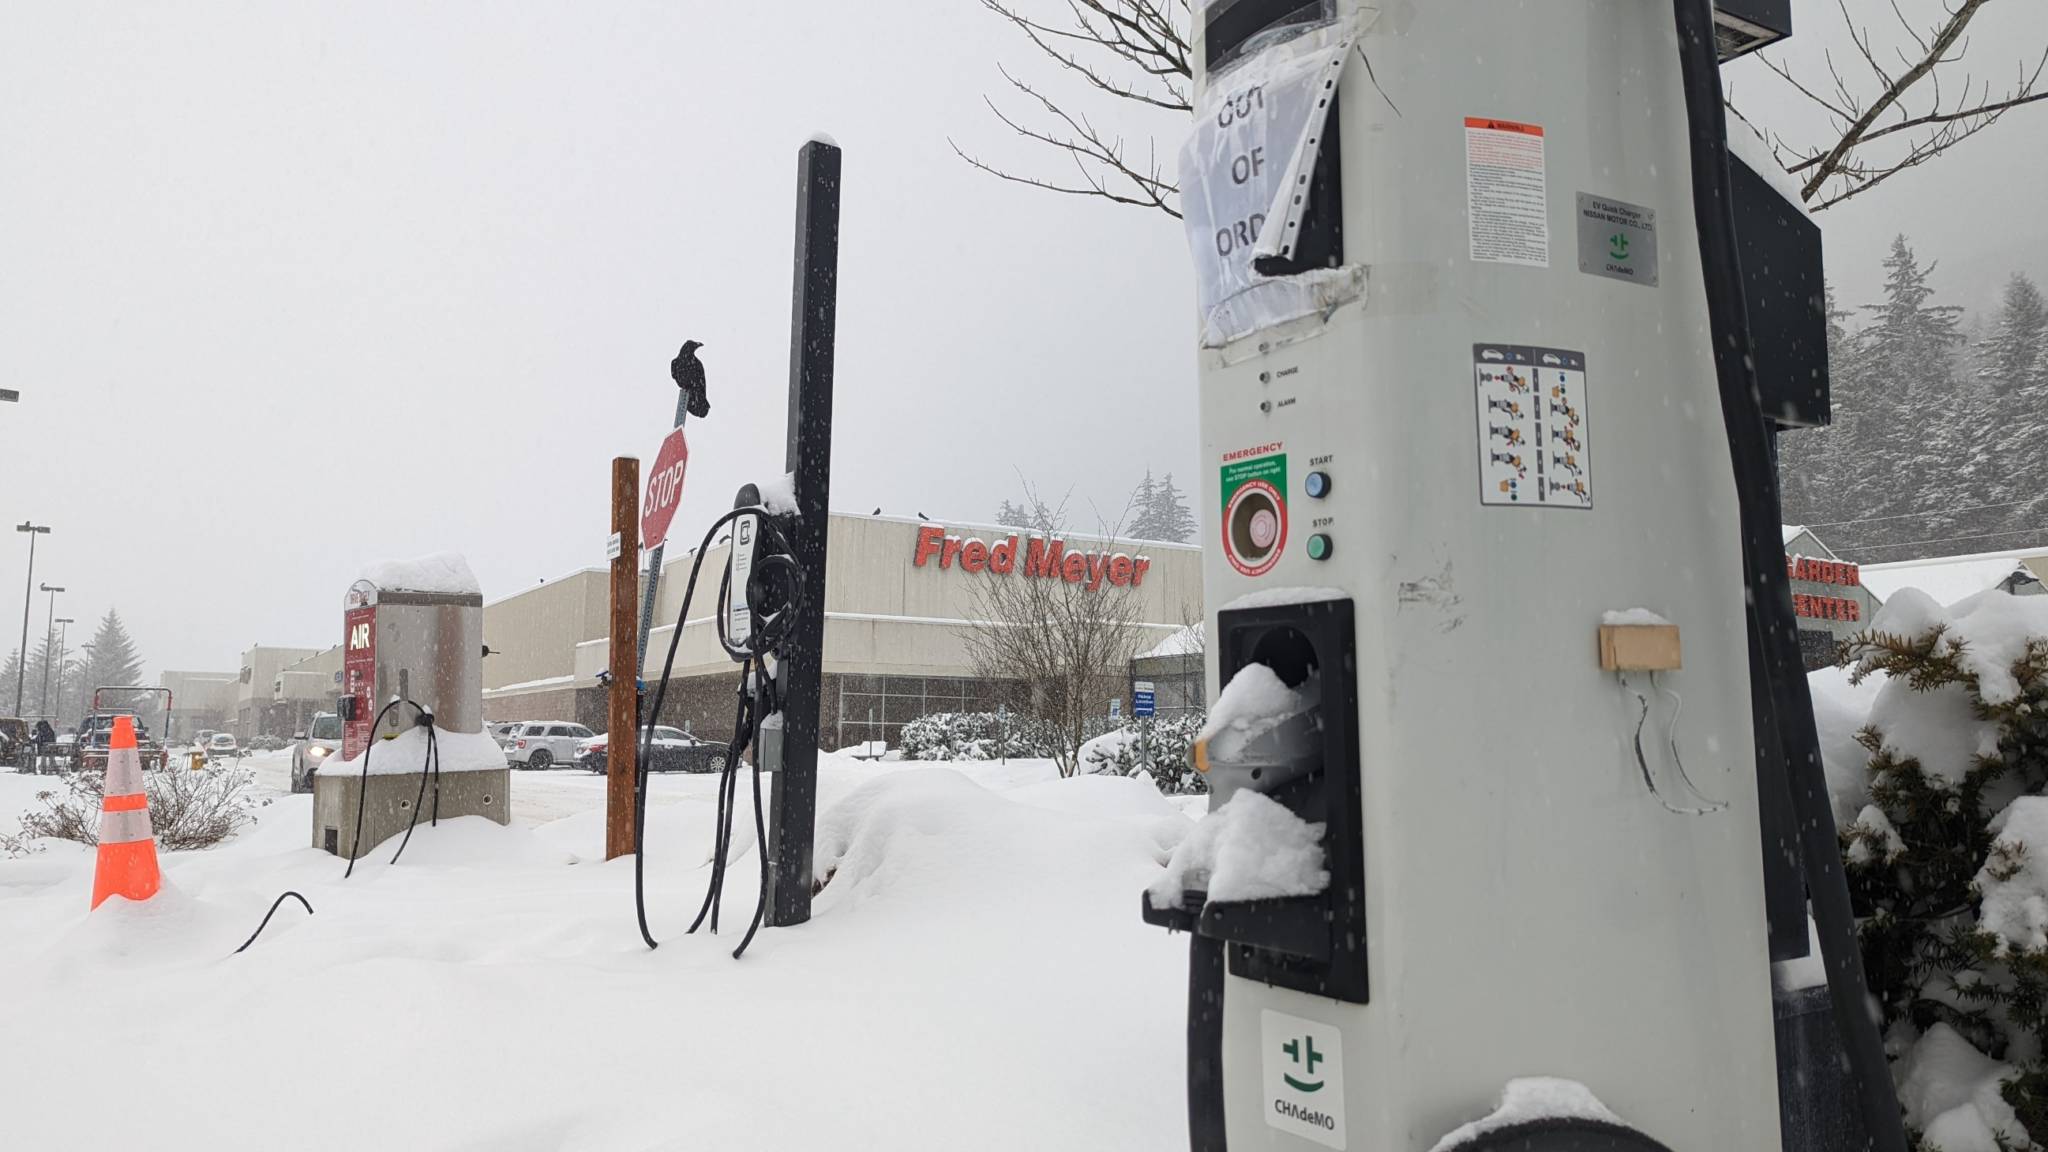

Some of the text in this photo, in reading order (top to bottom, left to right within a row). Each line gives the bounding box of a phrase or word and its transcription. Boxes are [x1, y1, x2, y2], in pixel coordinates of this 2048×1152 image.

[1218, 84, 1267, 128] OUT
[1232, 147, 1265, 184] OF
[1583, 210, 1606, 220] NISSAN
[1607, 214, 1628, 224] MOTOR
[1602, 204, 1618, 213] Quick
[1620, 208, 1641, 219] Charger
[1216, 210, 1268, 256] ORD
[1222, 441, 1283, 461] EMERGENCY
[1309, 455, 1333, 466] START
[645, 460, 683, 517] STOP
[1312, 517, 1334, 528] STOP
[914, 526, 1151, 592] Fred Meyer
[1793, 594, 1860, 621] ENTER
[350, 623, 370, 650] AIR
